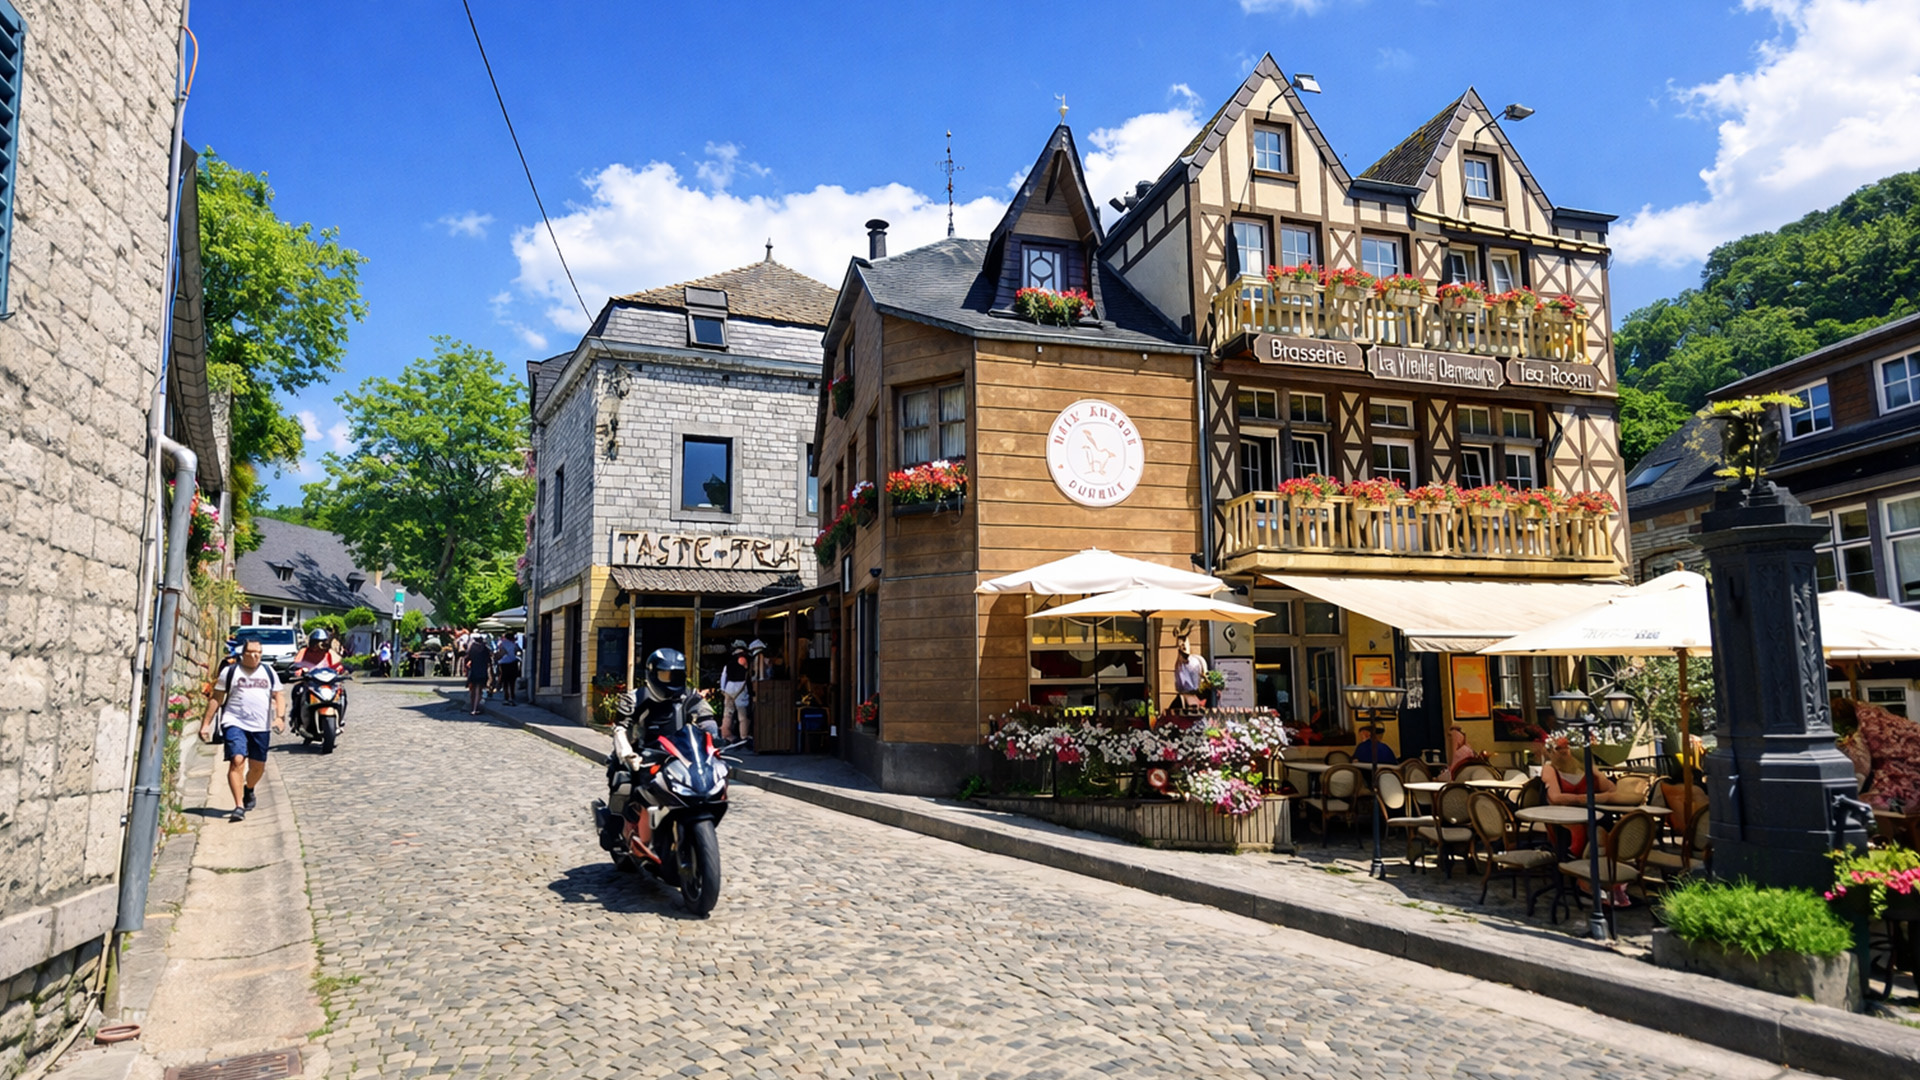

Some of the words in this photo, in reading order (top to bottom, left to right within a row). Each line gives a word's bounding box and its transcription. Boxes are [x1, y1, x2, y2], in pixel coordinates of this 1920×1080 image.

[1271, 338, 1348, 365] Brasserie
[1516, 361, 1544, 384] Tea
[1550, 364, 1592, 390] Room
[618, 533, 712, 567] TASTE
